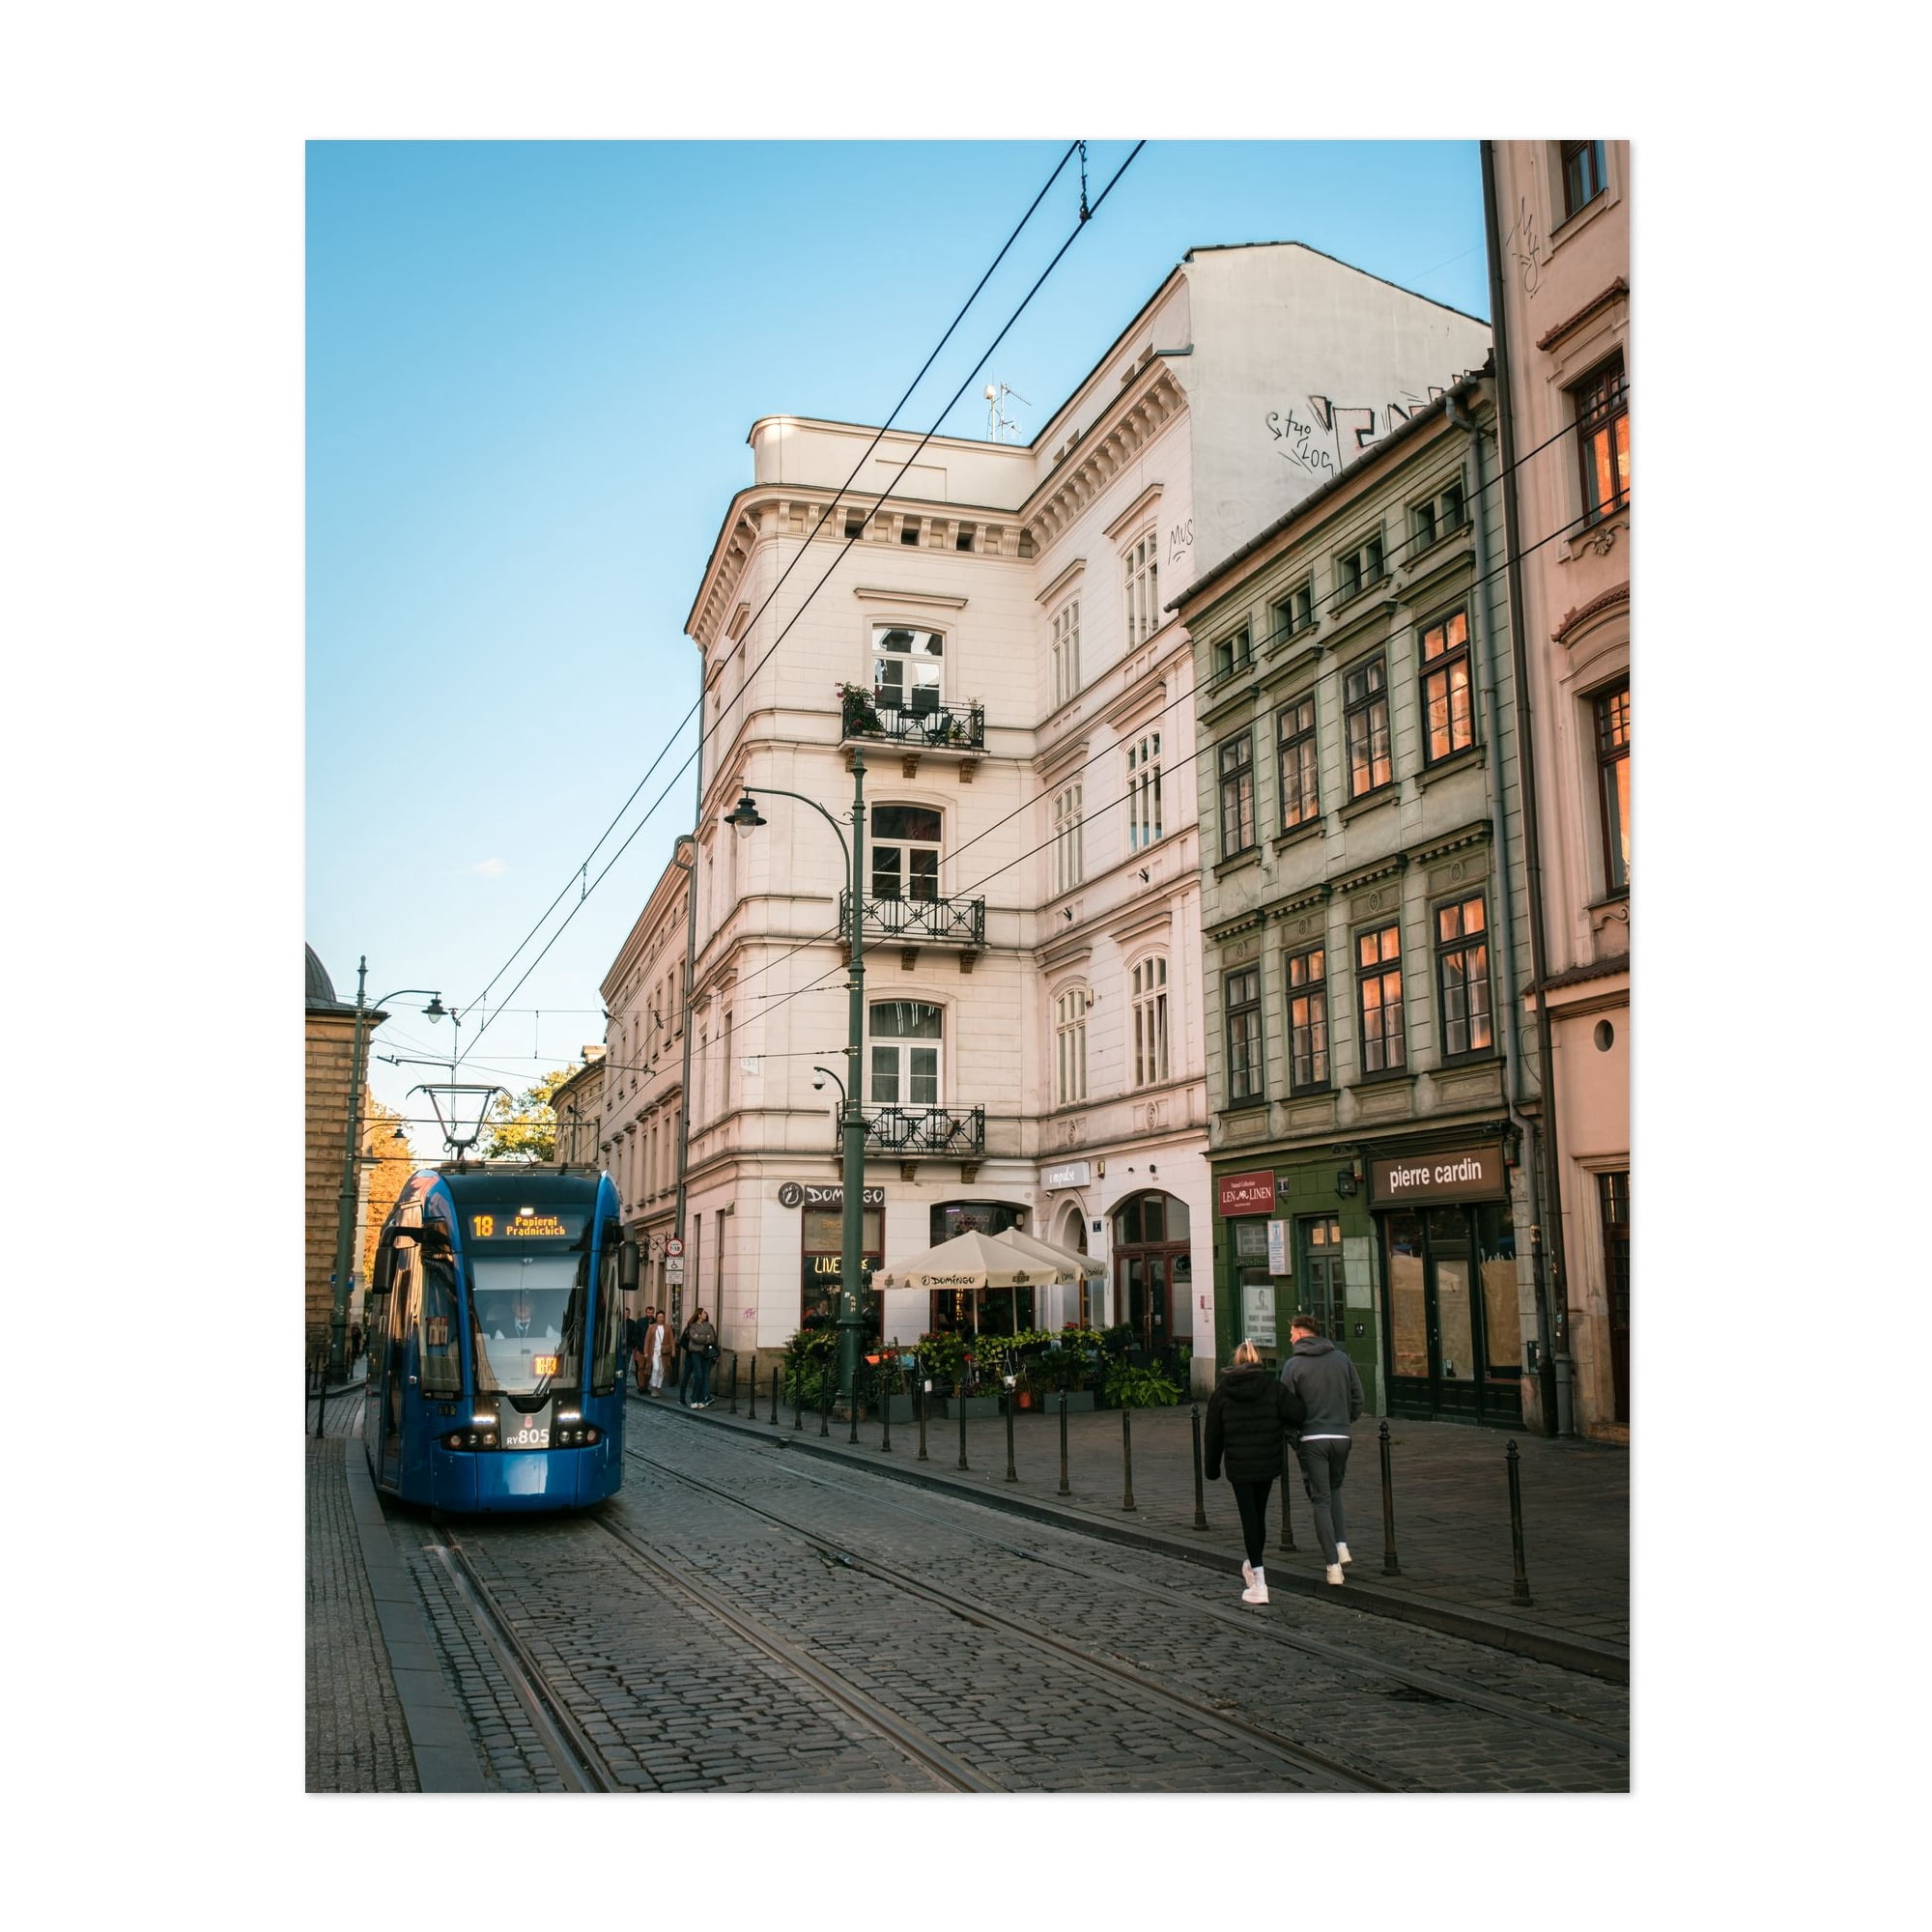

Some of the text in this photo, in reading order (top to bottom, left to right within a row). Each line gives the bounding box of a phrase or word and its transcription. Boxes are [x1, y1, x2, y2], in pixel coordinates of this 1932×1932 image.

[1390, 1157, 1482, 1193] pierre cardin
[806, 1187, 884, 1204] DOMGO
[1223, 1191, 1236, 1203] LEN
[1249, 1186, 1271, 1200] LINEN
[473, 1215, 494, 1236] 18
[515, 1216, 557, 1227] Papierni
[814, 1257, 841, 1274] LIVE
